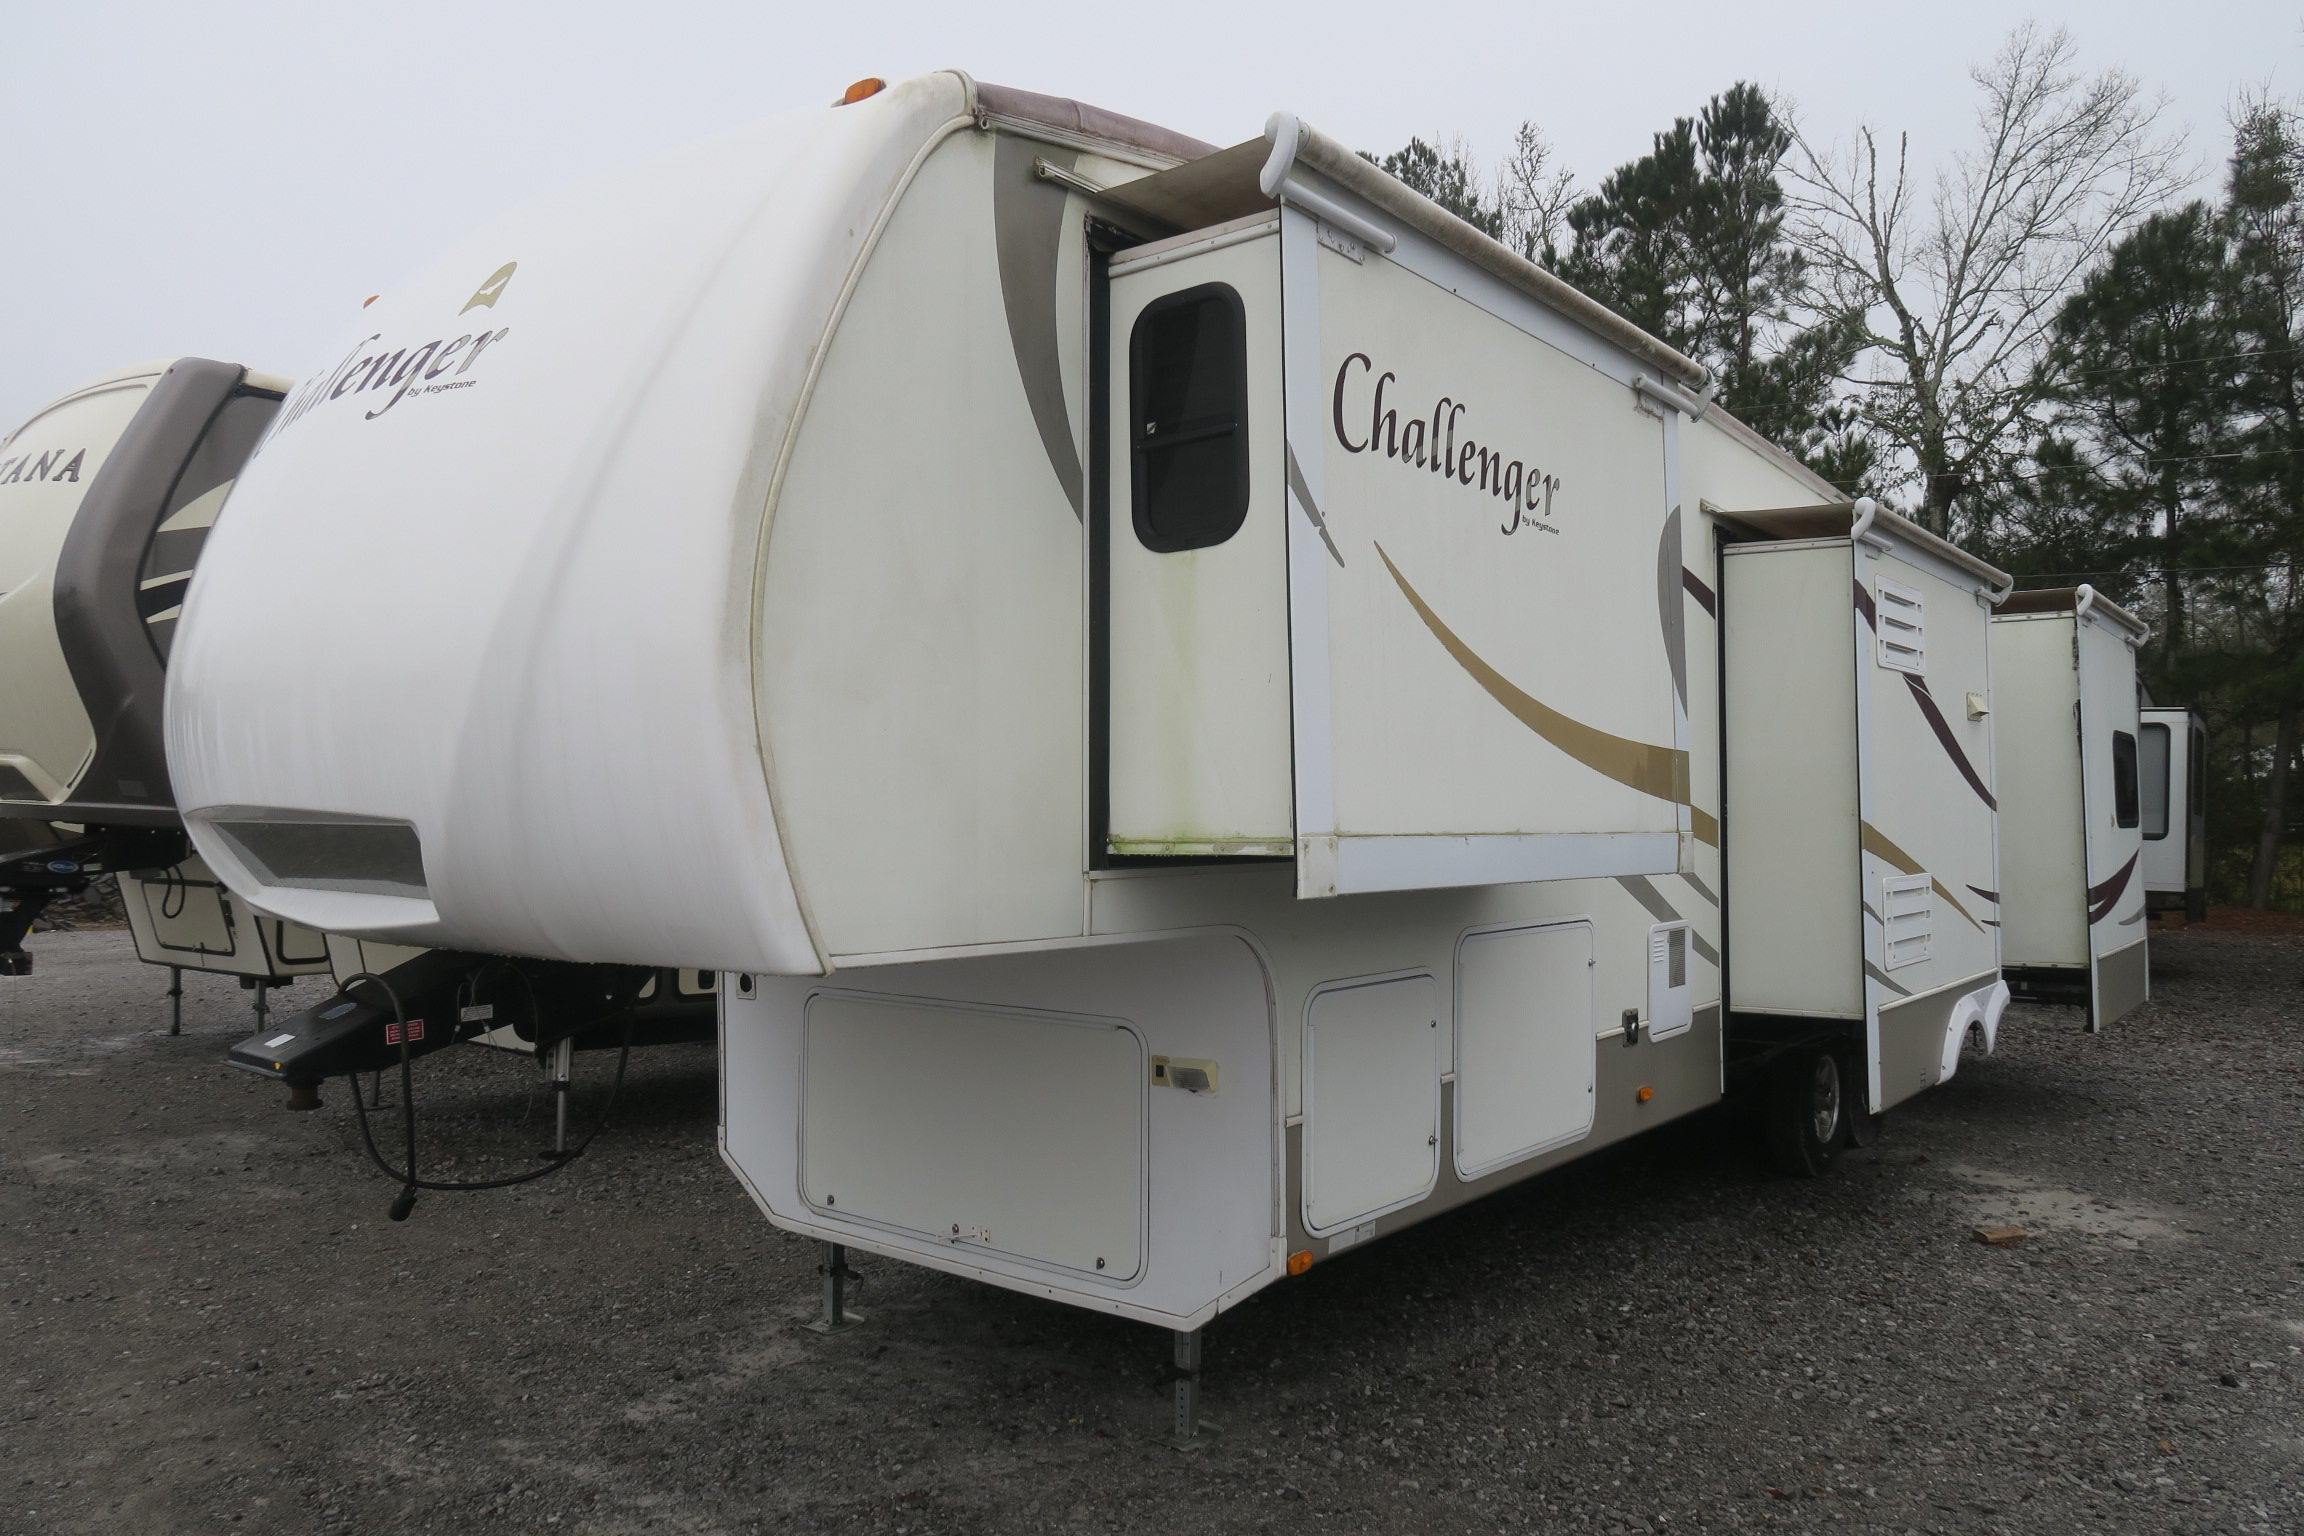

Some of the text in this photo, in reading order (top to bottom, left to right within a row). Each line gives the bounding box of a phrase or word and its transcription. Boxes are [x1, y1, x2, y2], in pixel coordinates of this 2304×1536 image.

[407, 381, 476, 397] by Keystone
[1333, 352, 1560, 535] Challenger
[1522, 514, 1560, 535] by Keystone
